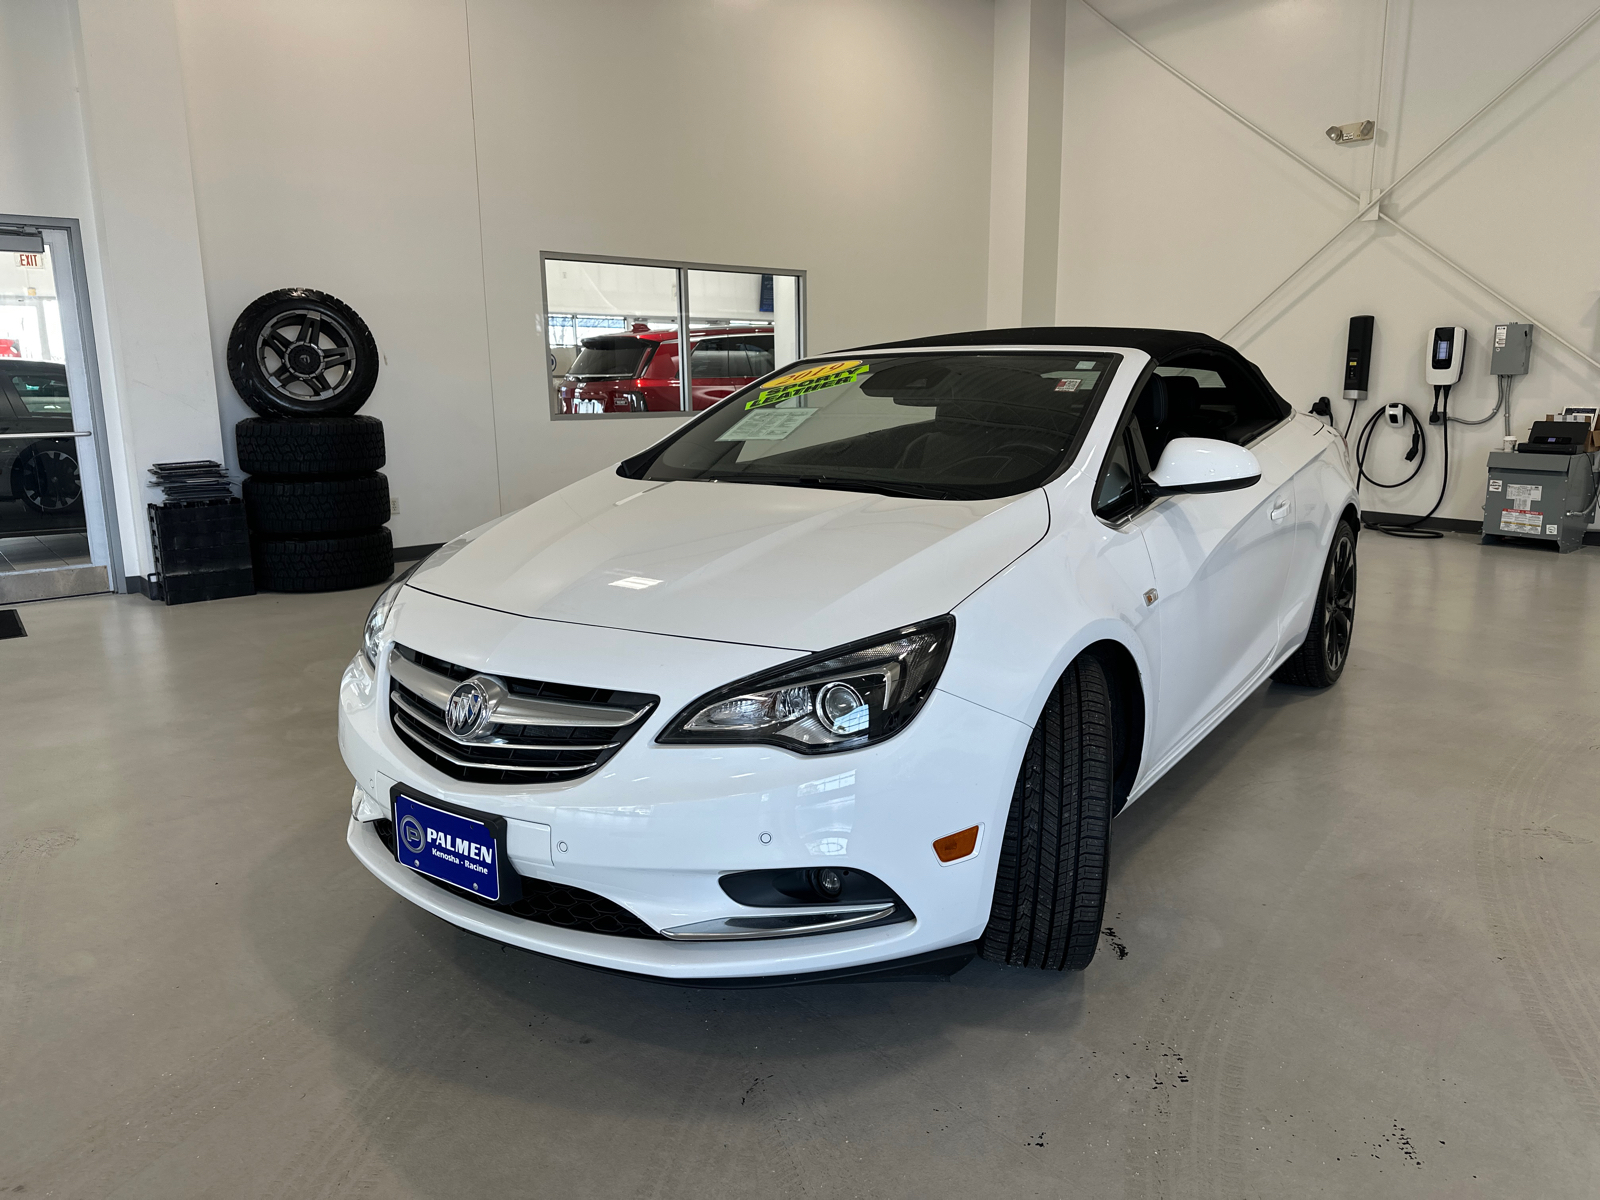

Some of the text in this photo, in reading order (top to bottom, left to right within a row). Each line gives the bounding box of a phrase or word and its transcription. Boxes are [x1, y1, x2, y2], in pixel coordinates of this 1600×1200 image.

[20, 254, 38, 266] EXIT
[765, 366, 864, 397] SPORTY
[774, 363, 845, 386] 2019
[750, 376, 854, 407] LEATHER
[426, 827, 493, 864] PALMEN
[431, 847, 460, 865] Kenosha
[464, 859, 489, 875] Racine
